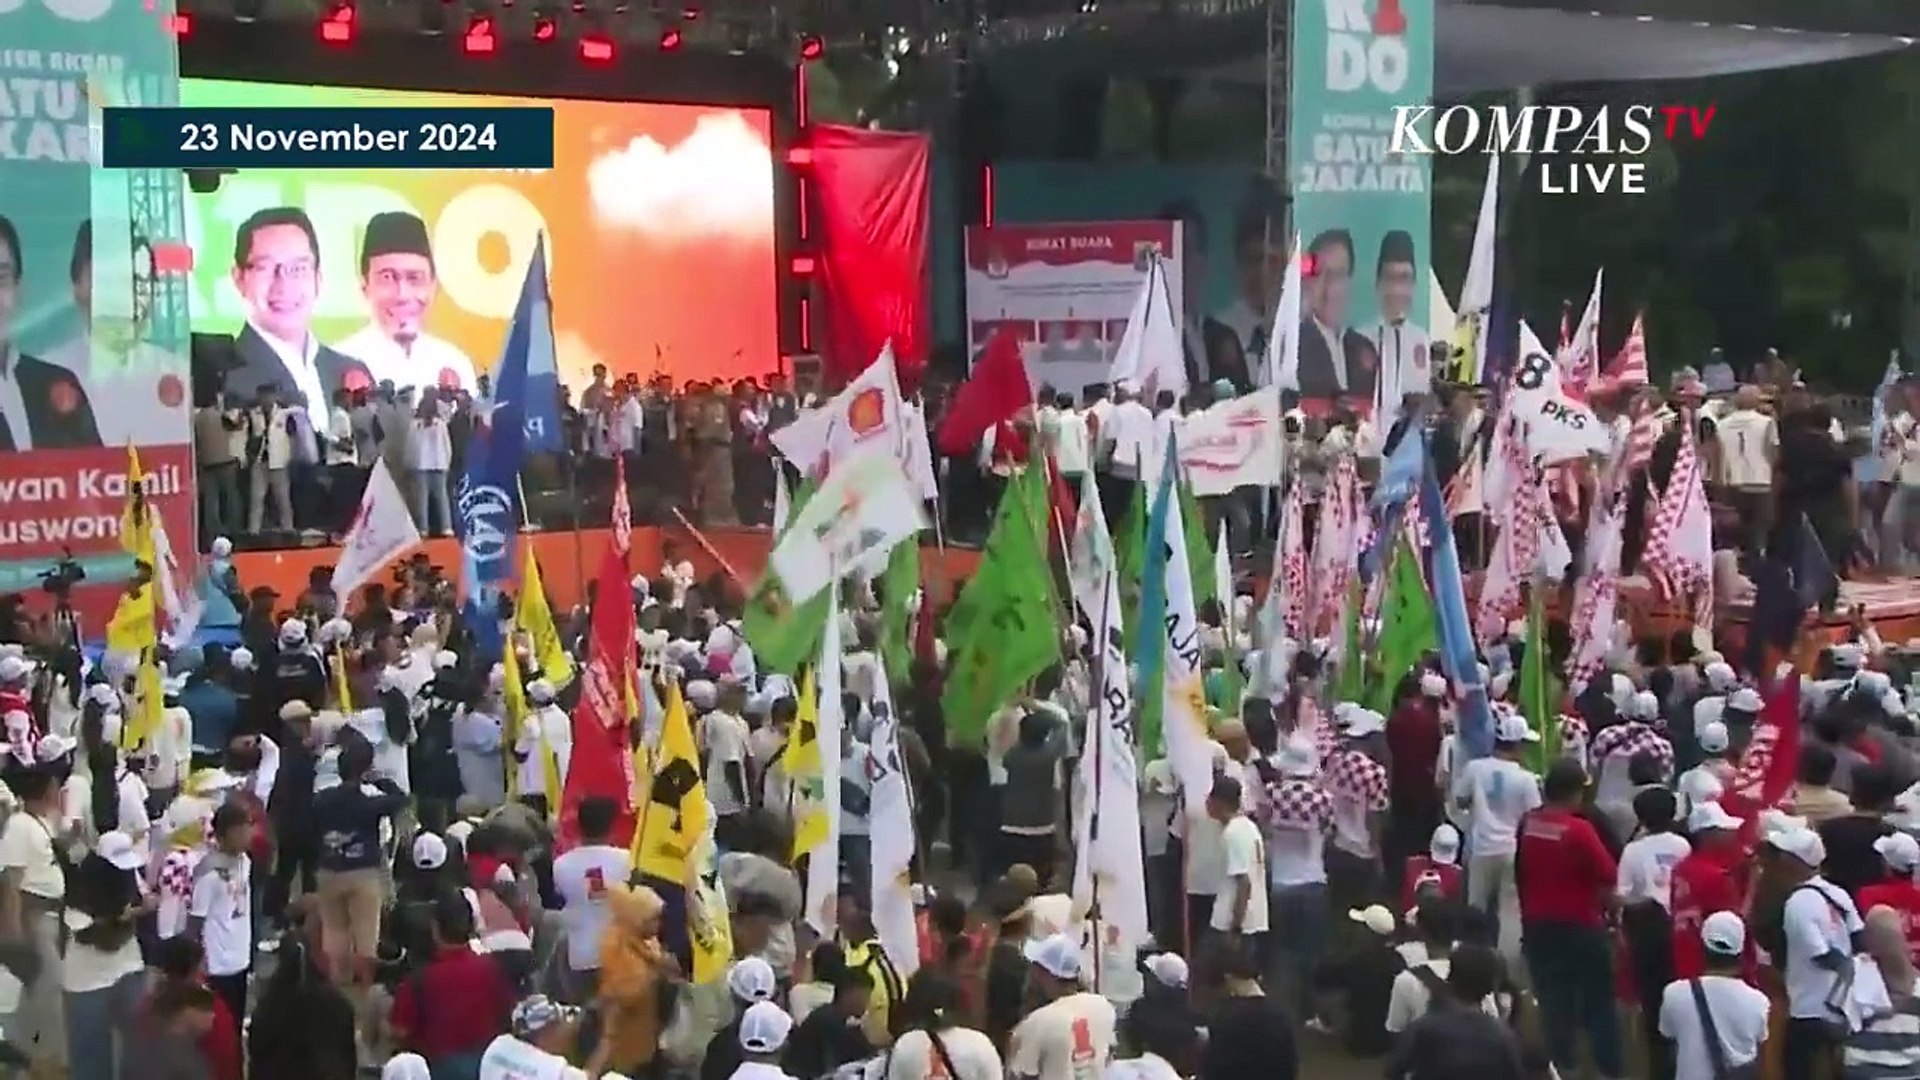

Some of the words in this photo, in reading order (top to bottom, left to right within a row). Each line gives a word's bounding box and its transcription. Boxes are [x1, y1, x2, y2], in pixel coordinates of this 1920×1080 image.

[1326, 32, 1408, 93] DO
[1516, 352, 1551, 389] 8
[1540, 400, 1588, 430] PKS
[0, 513, 128, 546] uswon
